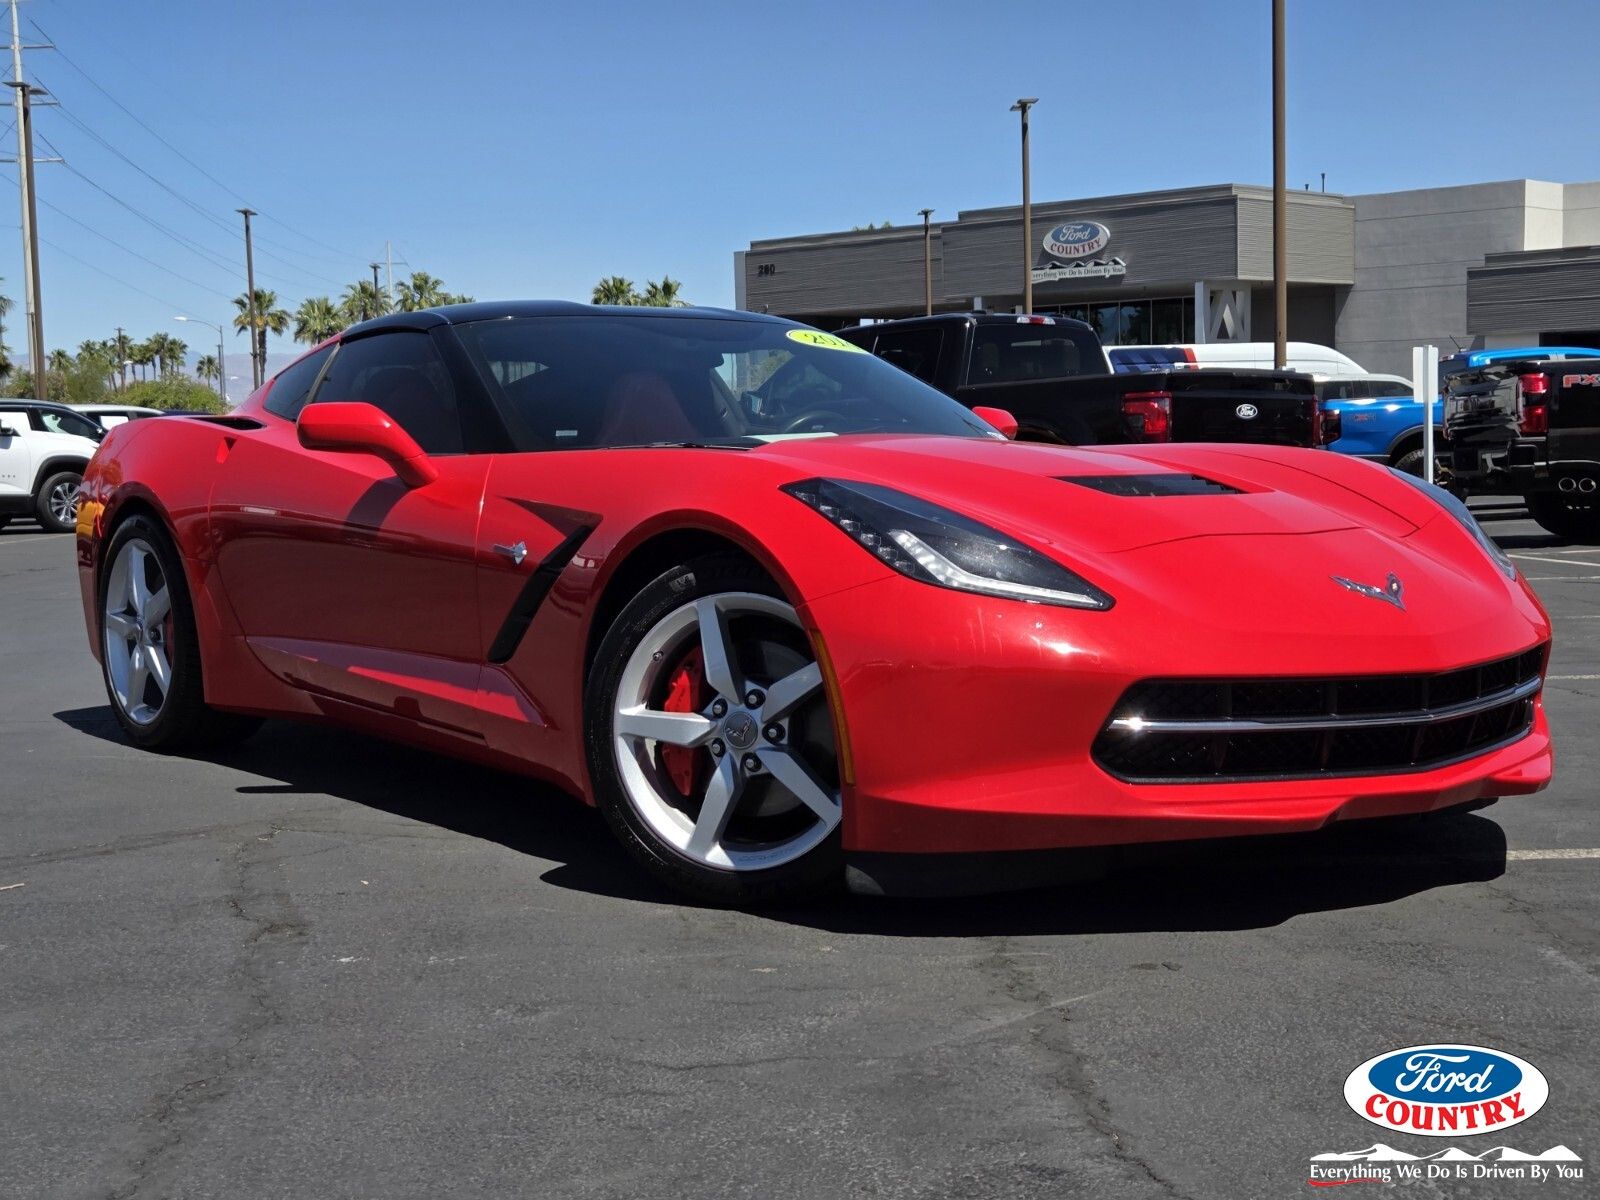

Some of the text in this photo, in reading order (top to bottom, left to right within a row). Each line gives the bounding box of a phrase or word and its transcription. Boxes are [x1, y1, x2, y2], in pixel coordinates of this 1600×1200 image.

[1060, 225, 1091, 241] Ford
[1051, 239, 1101, 255] COUNTRY
[1032, 271, 1058, 280] verything
[1083, 267, 1102, 275] Driven
[1103, 266, 1110, 275] By
[1239, 404, 1255, 416] Ford
